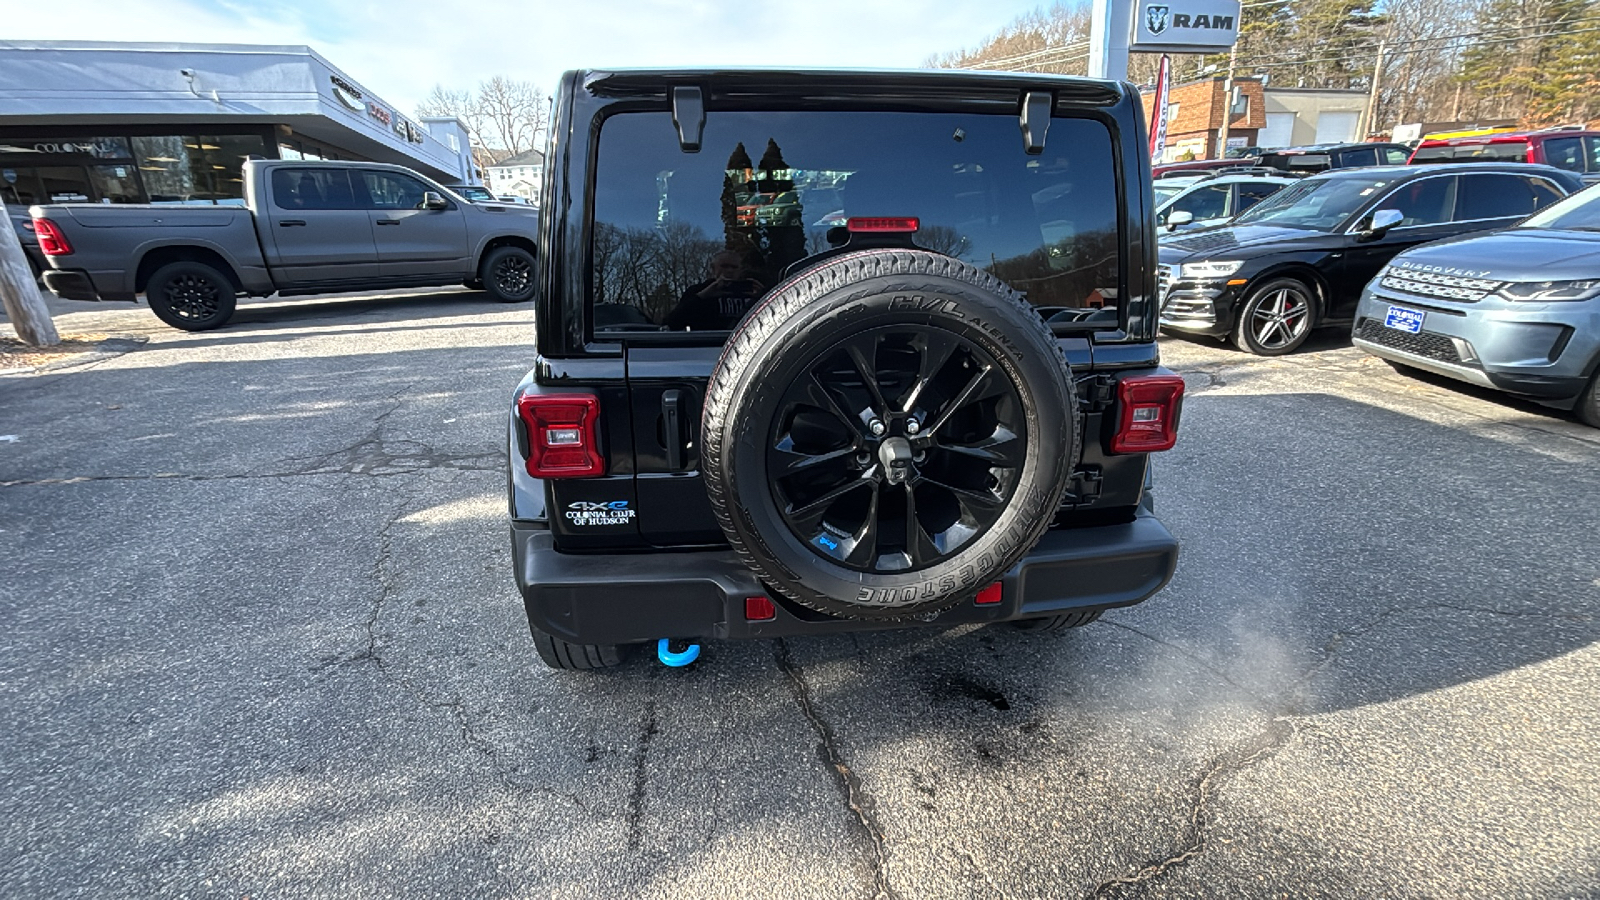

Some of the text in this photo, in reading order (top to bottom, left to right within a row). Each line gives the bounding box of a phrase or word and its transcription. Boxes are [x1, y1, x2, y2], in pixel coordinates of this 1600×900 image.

[1172, 13, 1234, 31] RAM
[1401, 261, 1491, 278] DISCOVERY
[968, 317, 1025, 362] ALENZA
[565, 509, 636, 519] COLONIAL CDJR
[573, 517, 629, 526] OF HUDSON
